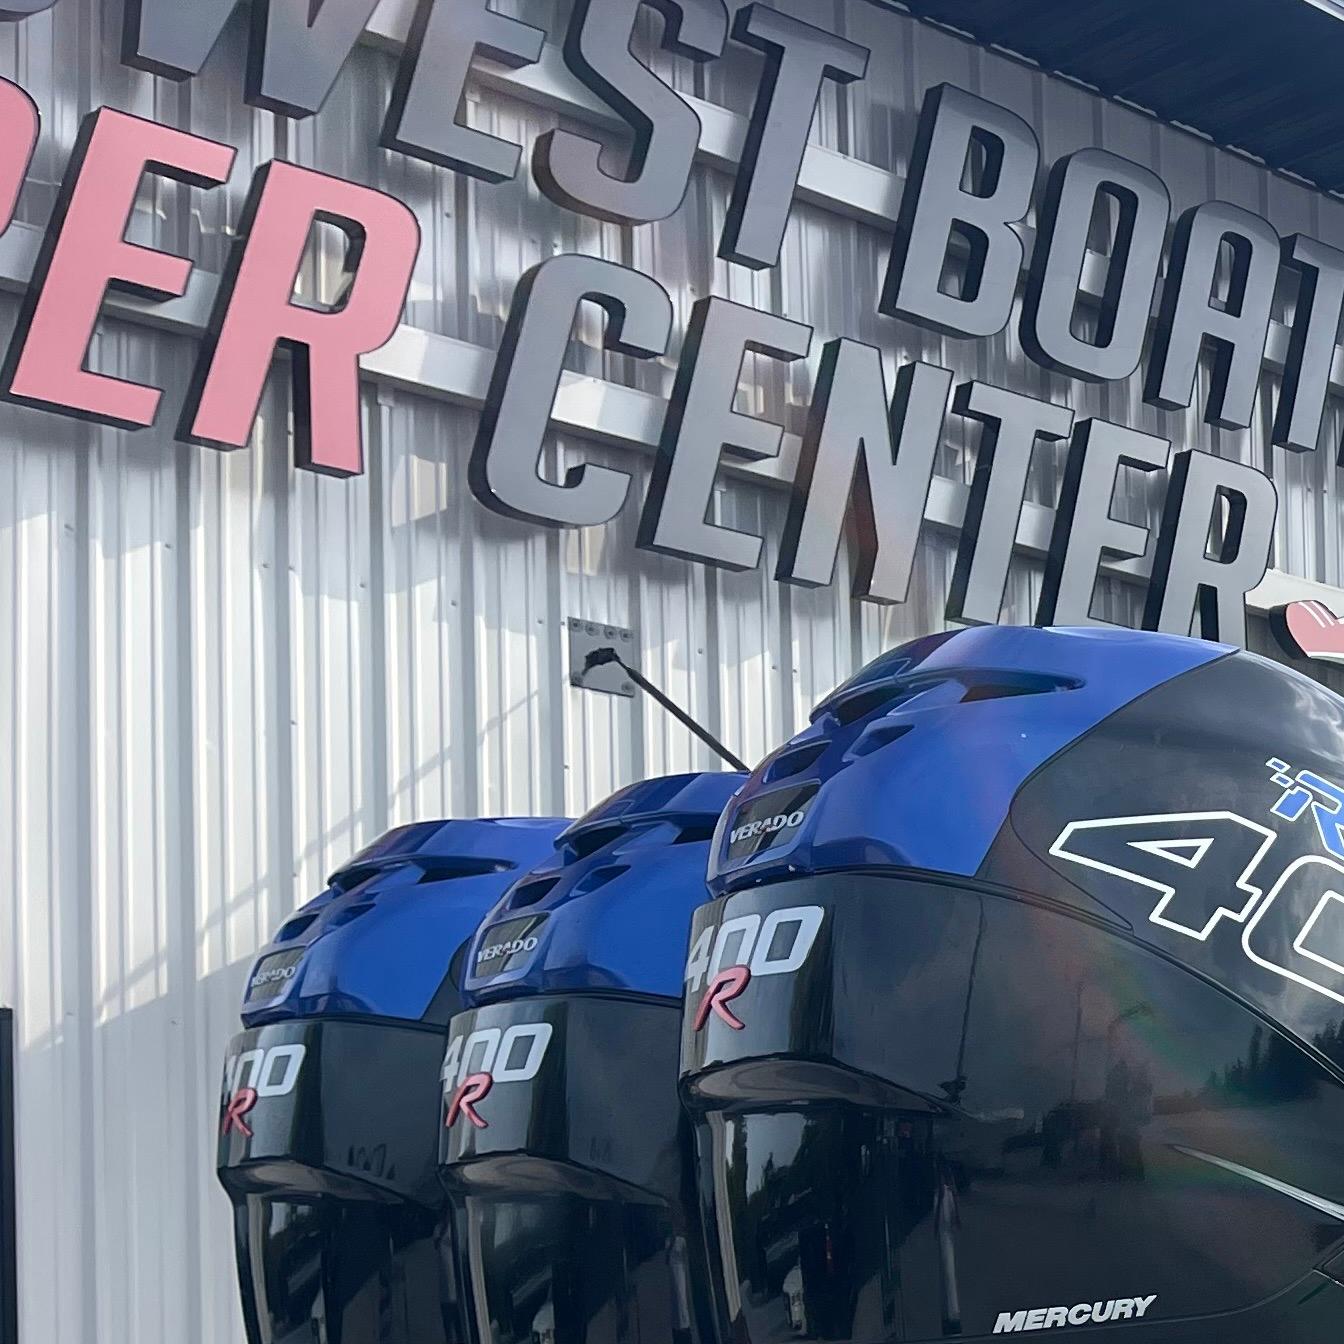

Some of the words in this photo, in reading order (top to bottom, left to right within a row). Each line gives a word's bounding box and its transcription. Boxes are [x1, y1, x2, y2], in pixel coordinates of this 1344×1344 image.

[469, 253, 1279, 650] CENTER
[730, 811, 805, 844] VERADO
[477, 937, 539, 963] VERADO
[684, 905, 824, 993] 400
[693, 964, 752, 1032] R
[440, 1023, 553, 1094] 400
[445, 1071, 490, 1129] R
[992, 1294, 1158, 1335] MERCURY
